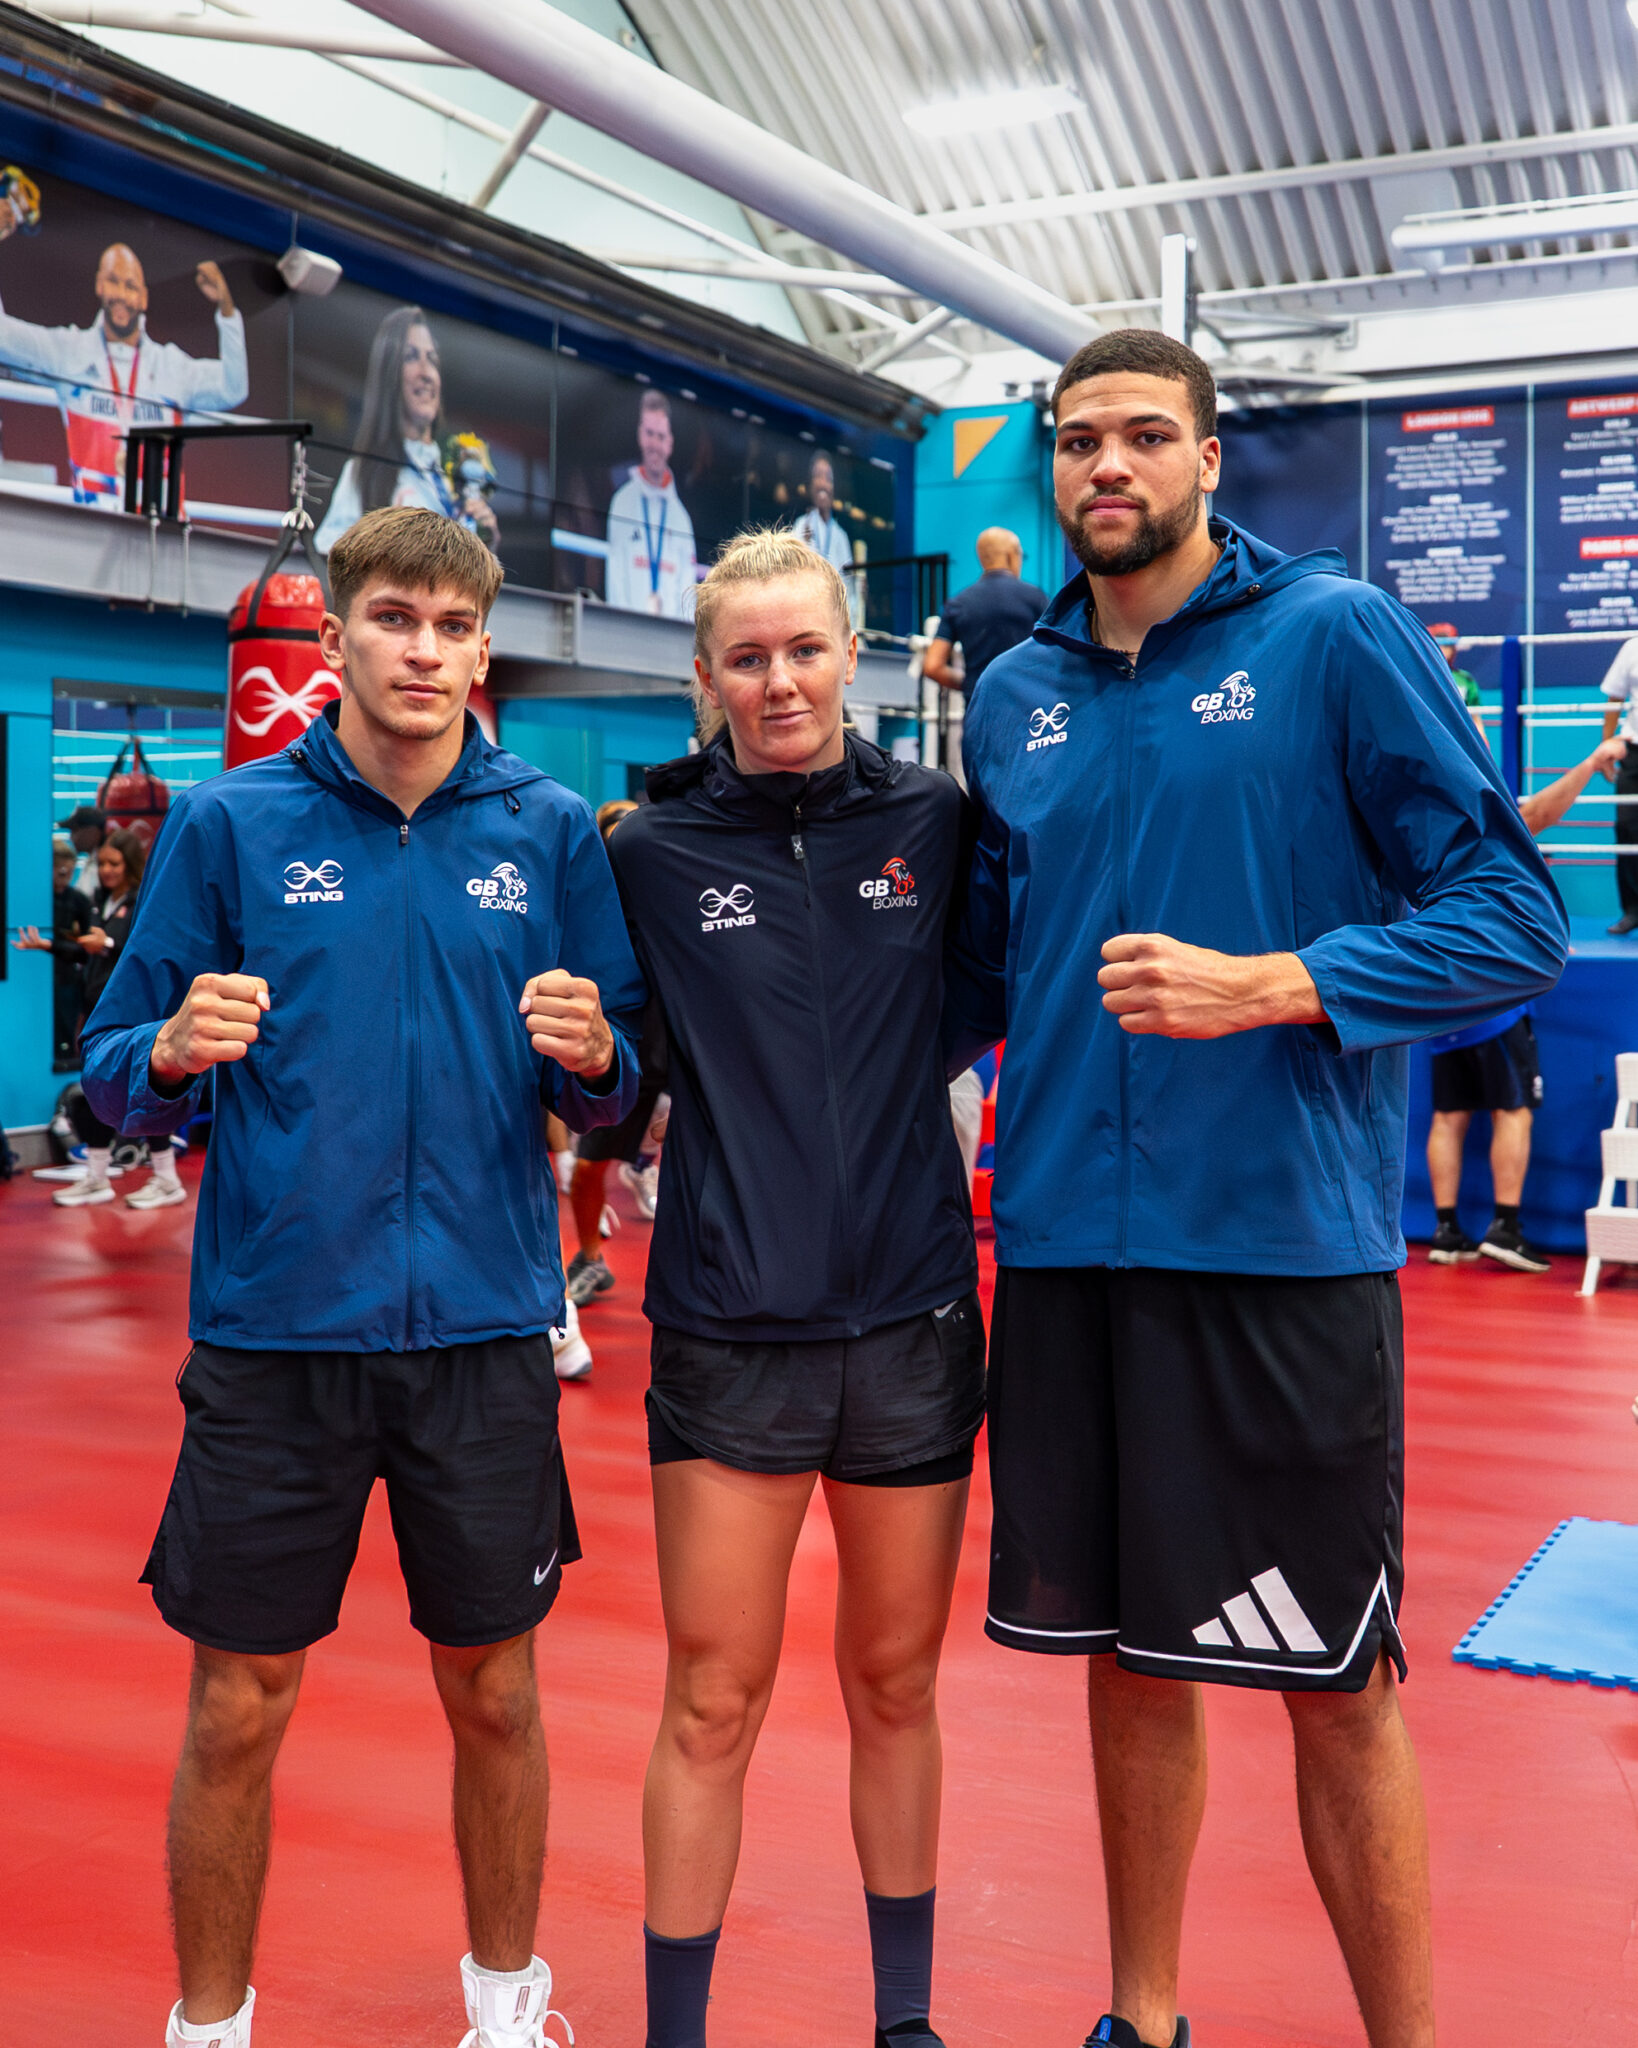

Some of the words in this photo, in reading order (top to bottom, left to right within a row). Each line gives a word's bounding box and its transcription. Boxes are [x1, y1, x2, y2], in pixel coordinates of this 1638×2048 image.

[1191, 692, 1225, 712] GB
[1200, 707, 1255, 724] BOXING
[1026, 731, 1068, 752] STING
[466, 878, 499, 897] GB
[859, 879, 890, 898] GB
[284, 890, 344, 904] STING
[479, 896, 528, 914] BOXING
[872, 895, 918, 910] BOXING
[701, 914, 756, 932] STING
